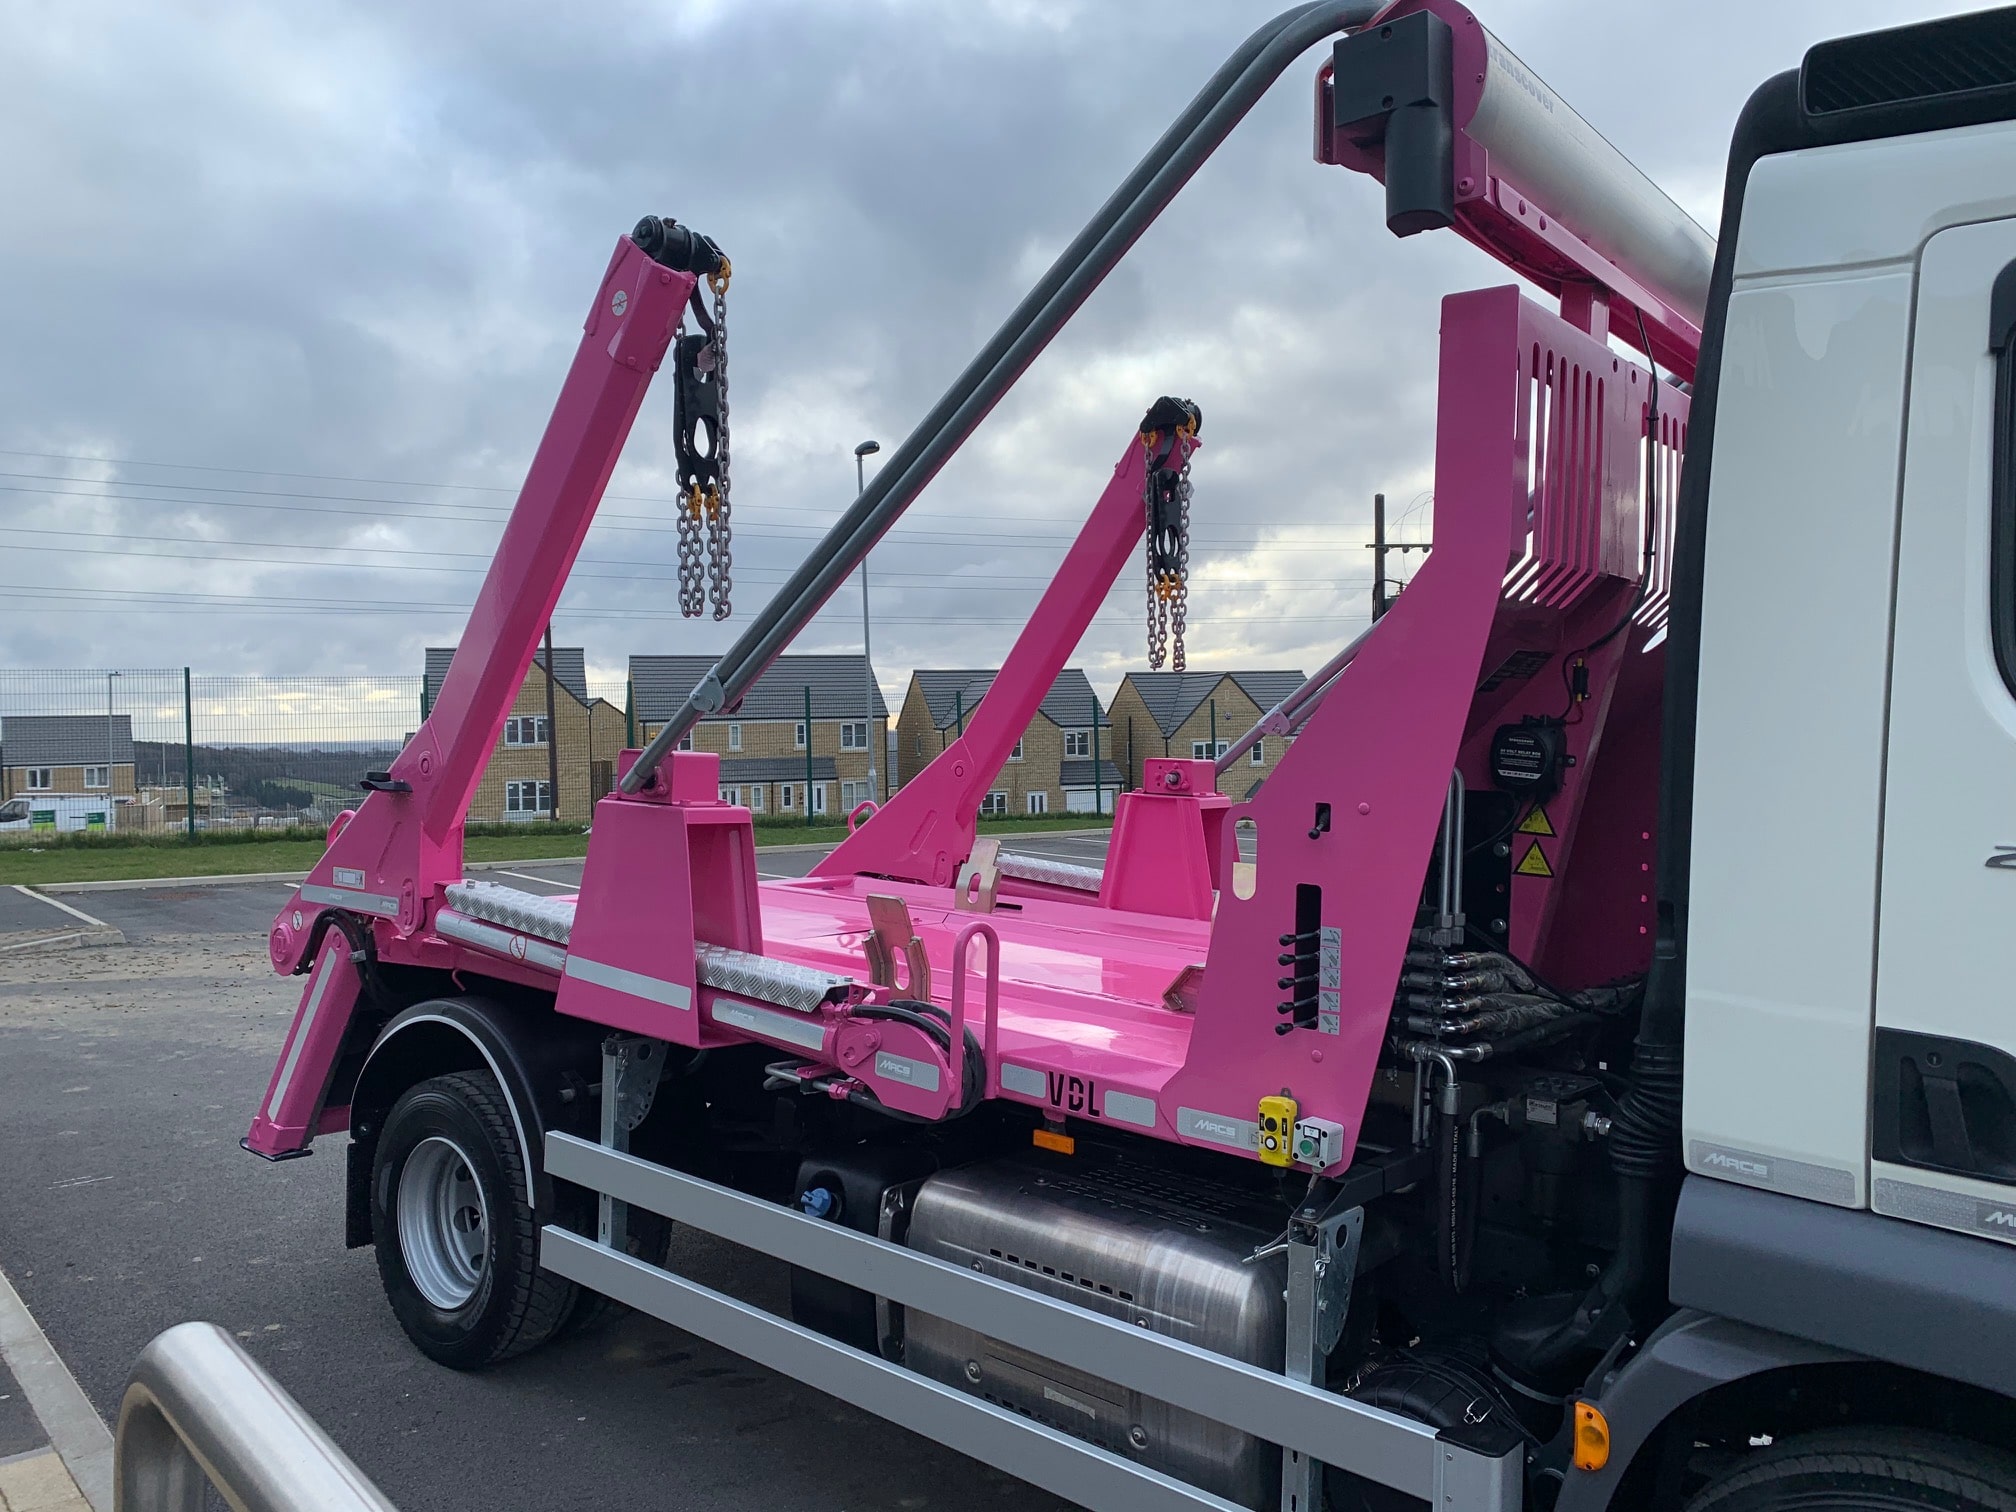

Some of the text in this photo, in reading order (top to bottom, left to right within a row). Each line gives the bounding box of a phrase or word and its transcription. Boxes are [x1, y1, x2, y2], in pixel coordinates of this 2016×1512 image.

[879, 1060, 911, 1076] MACS
[1048, 1070, 1101, 1117] VDL
[1194, 1119, 1236, 1137] MACS
[1703, 1152, 1768, 1177] MACS
